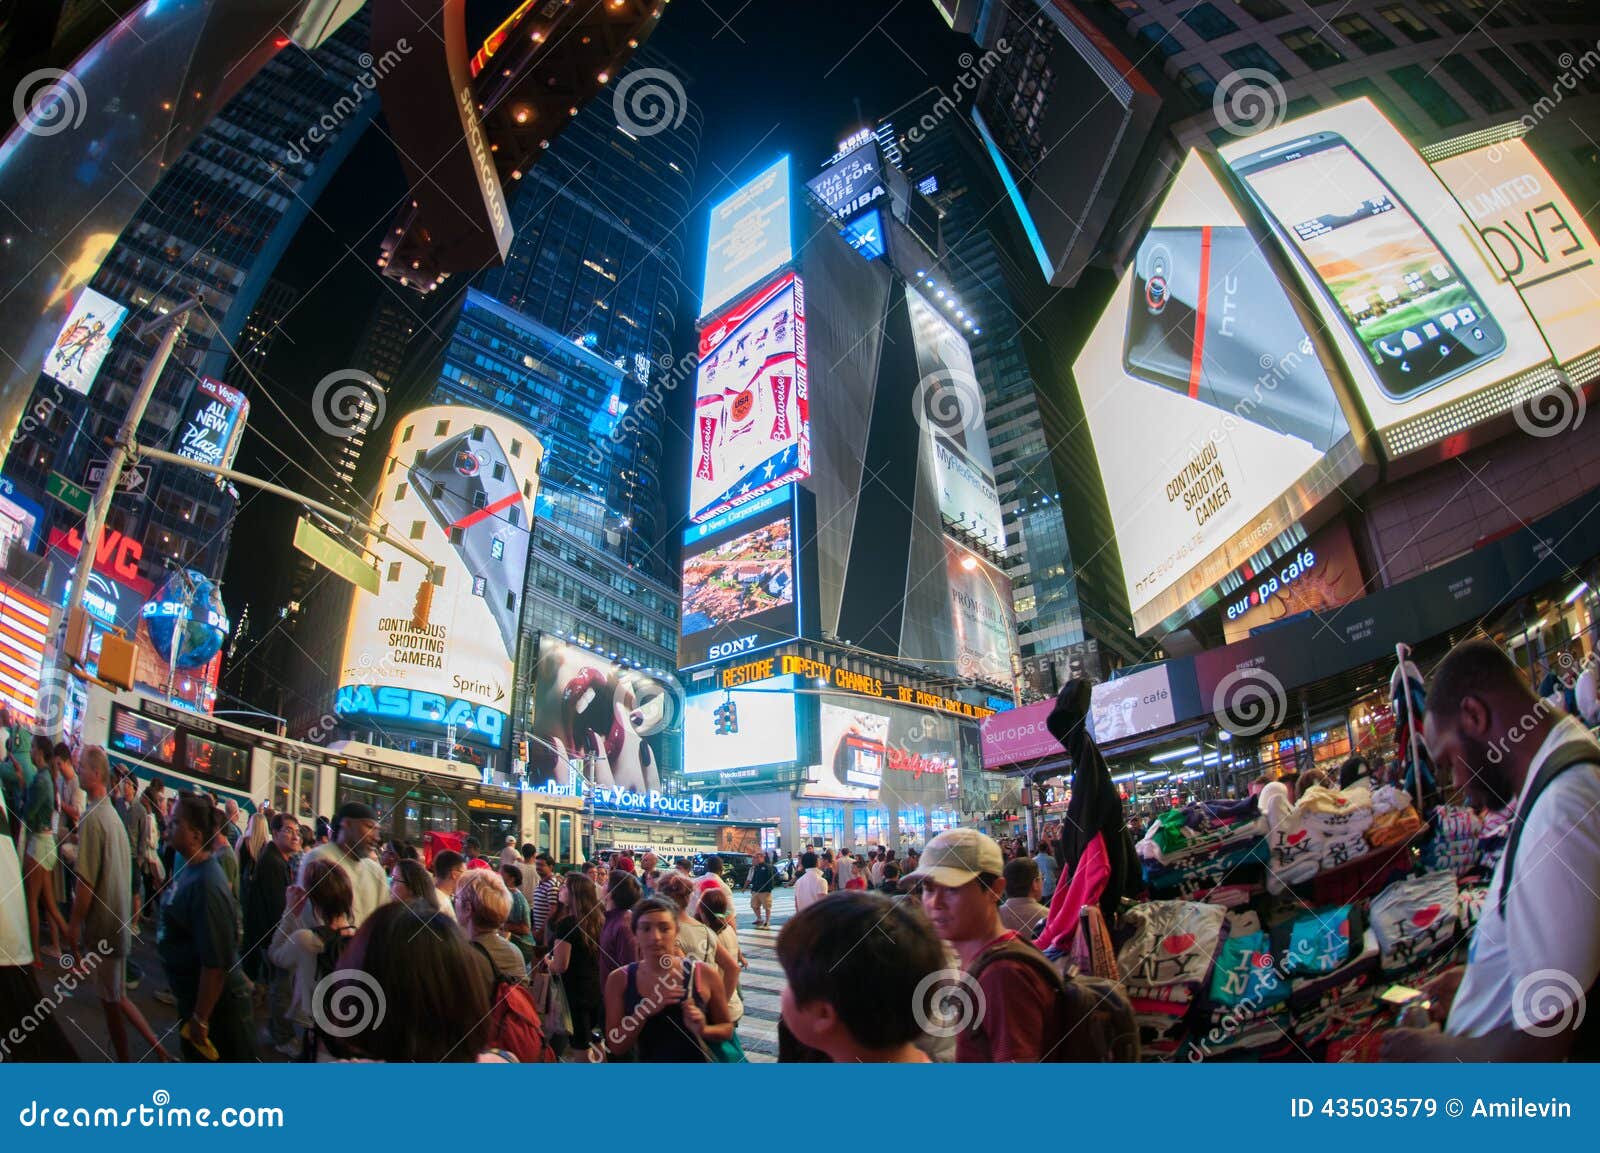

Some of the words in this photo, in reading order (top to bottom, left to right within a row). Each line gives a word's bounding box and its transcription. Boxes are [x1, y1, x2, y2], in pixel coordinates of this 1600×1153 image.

[461, 87, 505, 232] SPECTACOLOR
[815, 160, 860, 193] THAT'S
[845, 163, 873, 185] FOR
[826, 184, 854, 206] LIFE
[832, 186, 885, 218] HIBA
[794, 317, 807, 363] EDITION
[202, 378, 216, 392] Las
[797, 366, 809, 401] BUDS
[196, 409, 229, 435] NEW!
[206, 401, 227, 419] ALL
[182, 422, 224, 459] Plaza
[1167, 440, 1218, 502] CONTINUOU
[58, 480, 68, 498] 7
[1183, 460, 1224, 511] SHOOTIN
[729, 498, 772, 521] Corporation
[1196, 482, 1231, 526] CAMER
[1281, 548, 1315, 584] café
[389, 633, 444, 653] SHOOTING
[709, 634, 757, 659] SONY
[394, 649, 442, 669] CAMERA
[453, 674, 492, 699] Sprint
[723, 658, 775, 688] RESTORE
[782, 655, 831, 683] DIRECTV
[835, 668, 882, 697] CHANNELS
[1143, 688, 1168, 704] café
[336, 685, 504, 746] NASDAQ
[985, 723, 1035, 745] europa
[613, 785, 647, 807] YORK
[650, 790, 690, 812] POLICE
[692, 794, 721, 813] DEPT
[1132, 953, 1199, 980] NY
